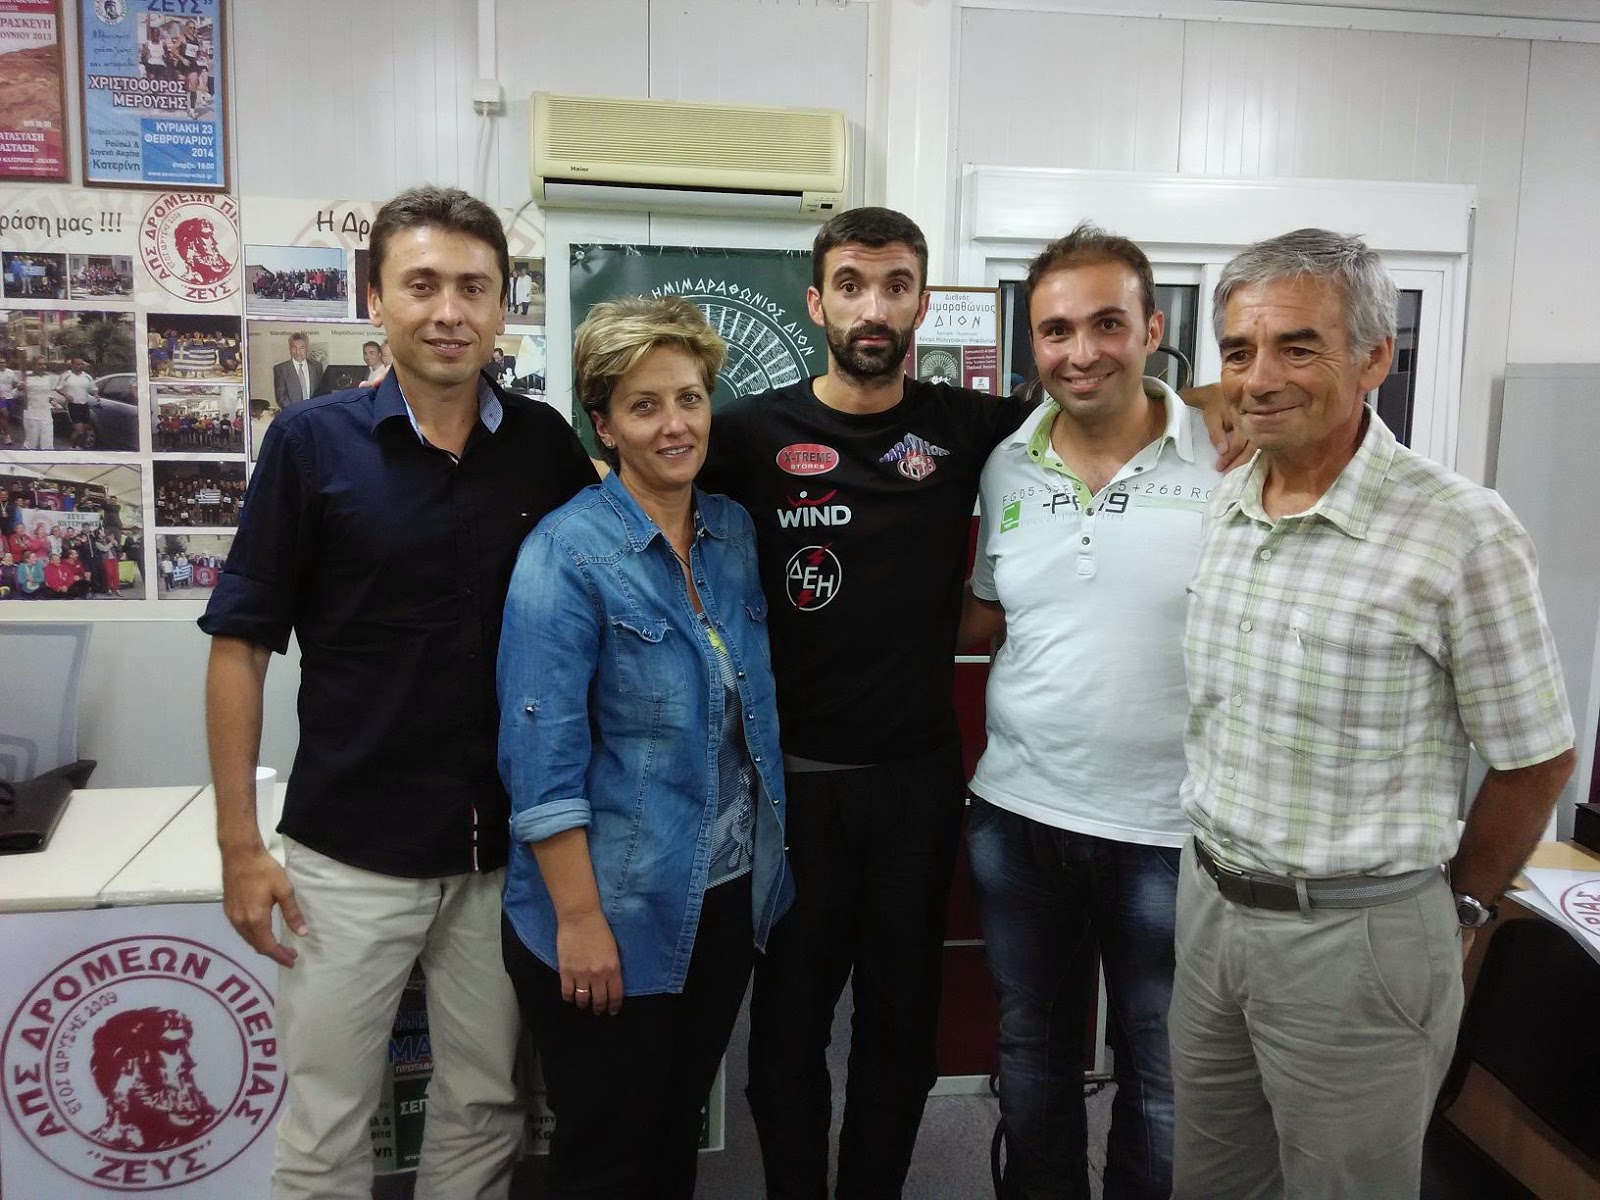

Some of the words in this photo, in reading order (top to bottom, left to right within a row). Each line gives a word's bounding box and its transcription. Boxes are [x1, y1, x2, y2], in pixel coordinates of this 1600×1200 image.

[90, 76, 186, 93] ΧΡΙΣΤΟΦΟΡΟΣ
[113, 93, 188, 110] ΜΕΡΟΥΣΗΣ
[144, 133, 213, 146] ΦΕΒΡΟΥΑΡΙΟΥ
[156, 122, 199, 133] ΚΥΡΙΑΚΗ
[202, 124, 213, 134] 23
[191, 148, 214, 158] 2014
[92, 159, 141, 172] Κατερίνη
[56, 217, 93, 238] μας
[100, 212, 122, 232] !!!
[317, 210, 334, 232] Η
[145, 246, 171, 279] ΑΠΣ
[220, 201, 238, 229] ΠΙ
[652, 277, 786, 323] ΗΜΙΜΑΡΑΘΩΝΙΟΣ
[783, 322, 815, 359] ΔΙΟΝ
[784, 451, 831, 464] X-TREME
[777, 505, 852, 528] WIND
[789, 559, 834, 598] ΔΕΗ
[21, 947, 211, 1051] ΔΡΟΜΕΩΝ
[215, 974, 277, 1126] ΠΙΕΡΙΑΣ
[15, 1063, 67, 1137] ΑΠΣ
[56, 1080, 82, 1115] ΕΤΟΣ
